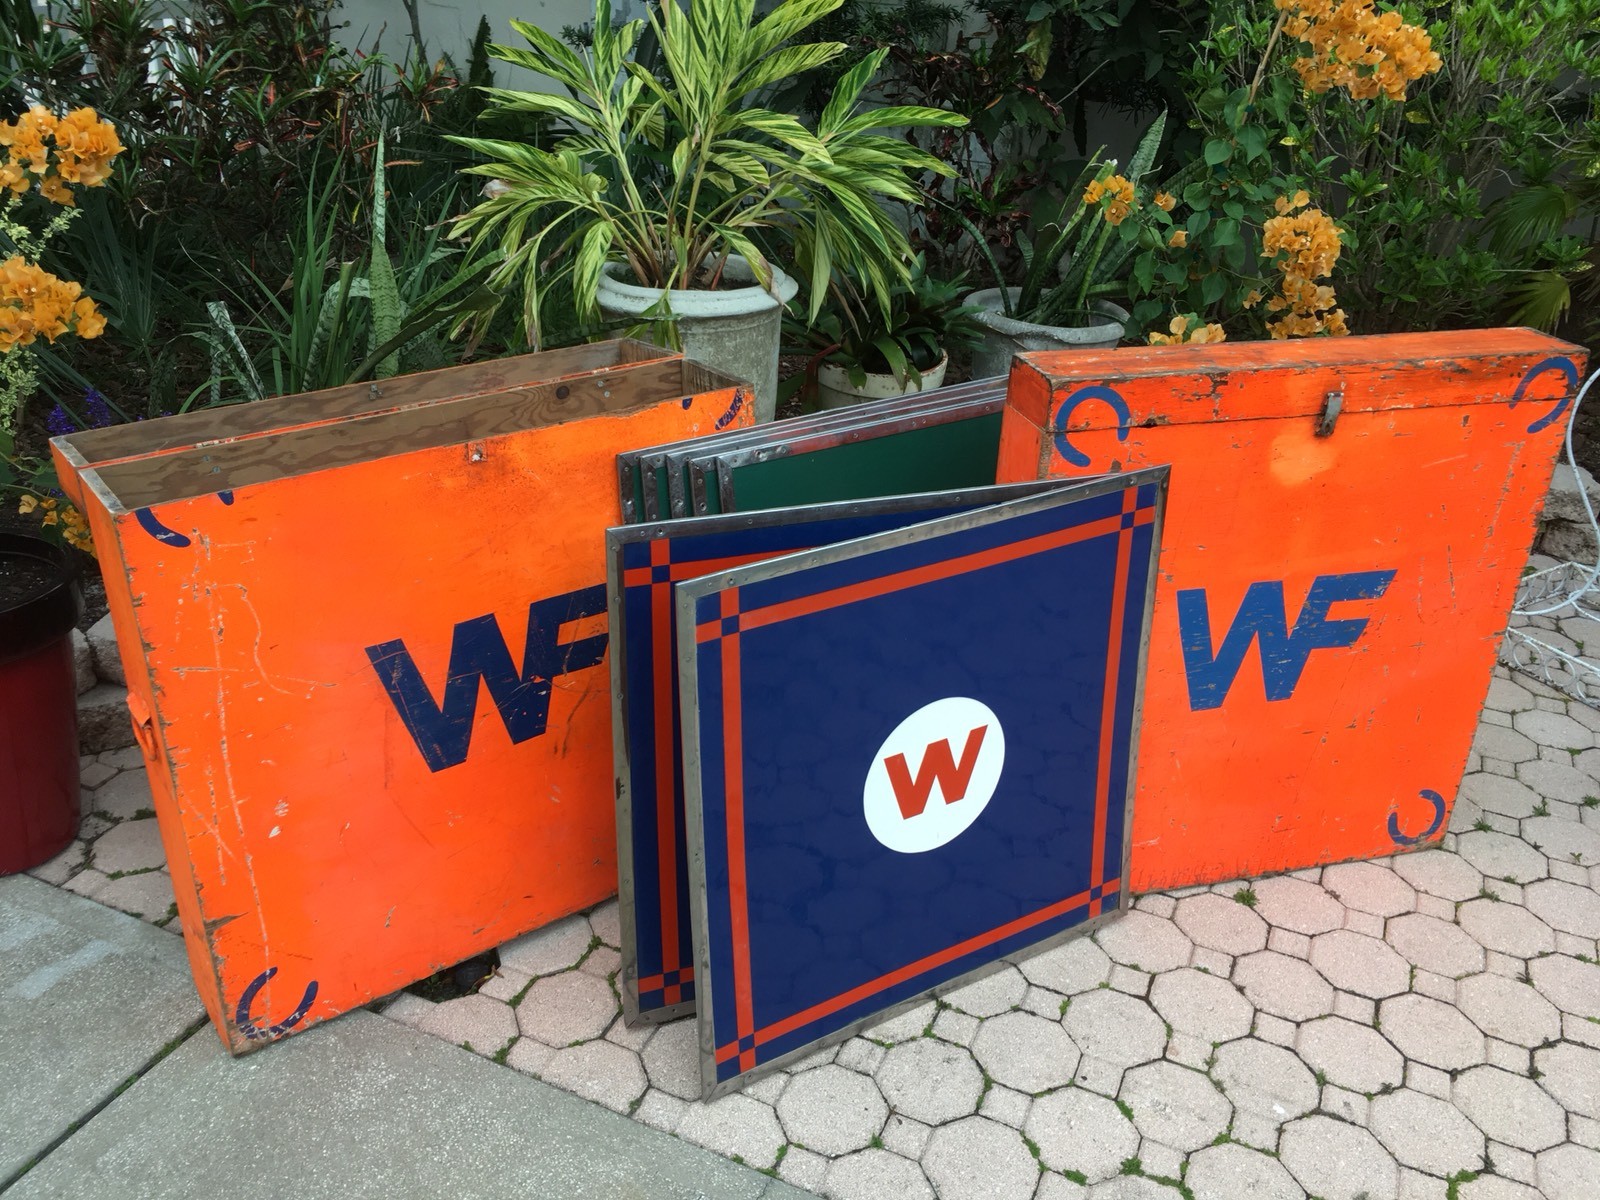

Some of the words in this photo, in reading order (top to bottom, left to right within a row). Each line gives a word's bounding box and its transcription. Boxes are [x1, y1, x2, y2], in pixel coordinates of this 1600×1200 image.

[364, 583, 608, 773] WF
[1176, 569, 1399, 712] WF
[883, 724, 988, 820] W
